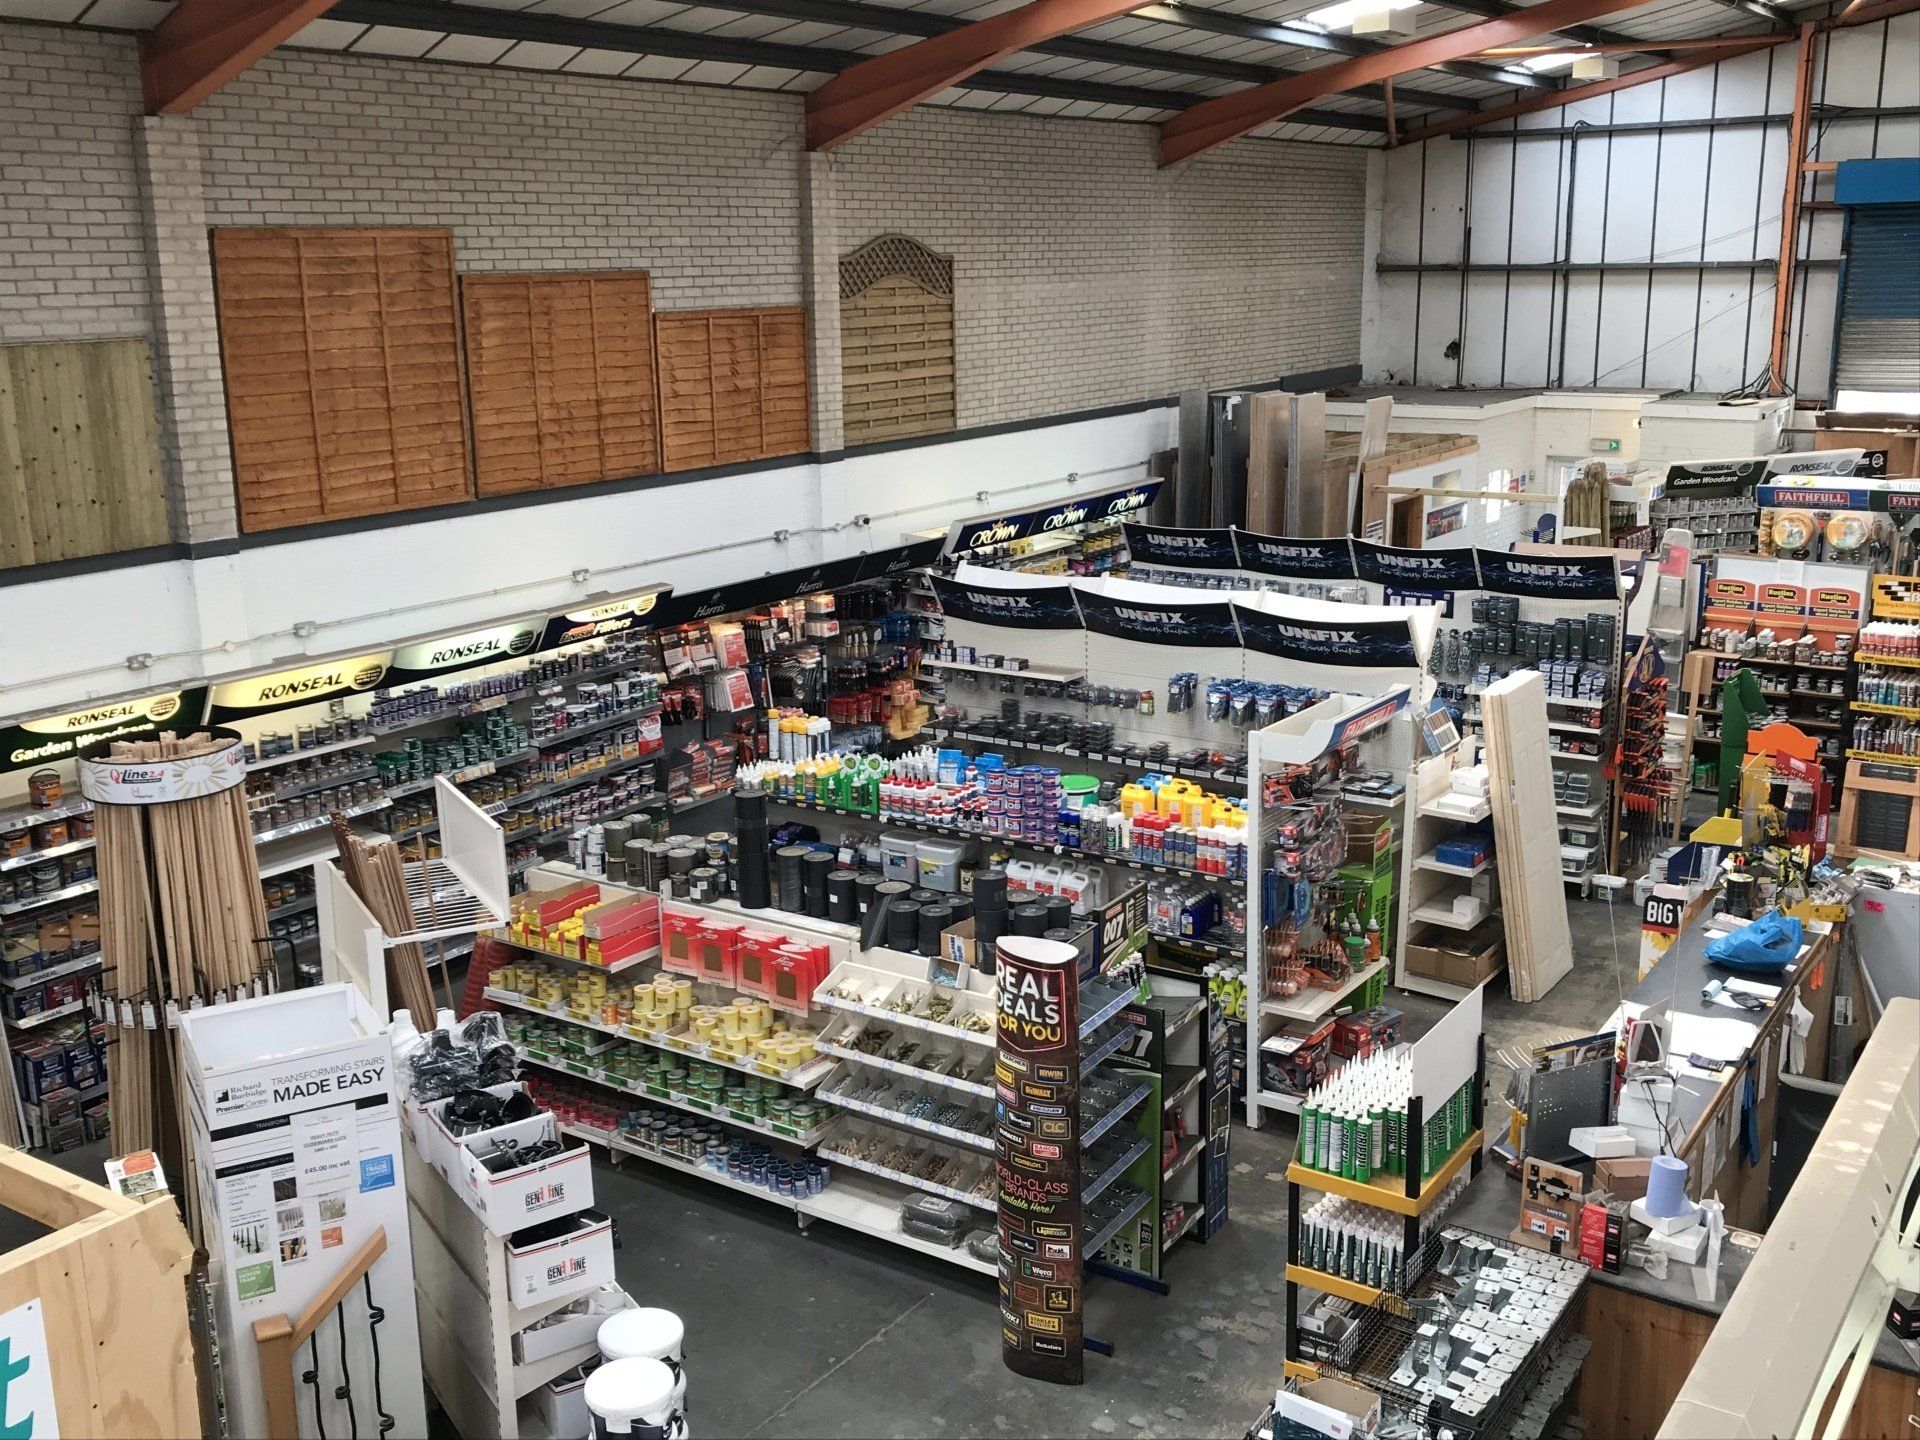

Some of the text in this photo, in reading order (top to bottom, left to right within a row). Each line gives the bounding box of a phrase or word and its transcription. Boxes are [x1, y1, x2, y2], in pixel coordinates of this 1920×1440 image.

[1701, 464, 1733, 472] RONSEAL
[1789, 461, 1836, 473] RONSEAL
[1673, 475, 1738, 486] Garden Woodcare
[1107, 492, 1148, 515] CROWN
[1779, 492, 1845, 503] FAITHFULL
[1043, 508, 1088, 531] CROWN
[969, 523, 1020, 548] CROWN
[886, 559, 911, 573] Harris
[795, 579, 824, 594] Harris
[1718, 584, 1744, 593] Rustins
[1768, 589, 1794, 597] Rustins
[1820, 593, 1847, 601] Rustins
[693, 604, 726, 618] Harris
[593, 617, 633, 635] Fillers
[430, 638, 502, 665] RONSEAL
[258, 673, 343, 701] RONSEAL
[66, 705, 136, 728] RONSEAL
[10, 739, 73, 763] Garden
[1647, 901, 1673, 924] BIG
[1103, 912, 1125, 945] 007
[996, 958, 1059, 1002] REAL
[996, 987, 1060, 1024] DEALS
[1021, 1020, 1061, 1042] YOU
[271, 1055, 385, 1087] TRANSFORMING STAIRS
[1039, 1069, 1063, 1078] IRWIN
[230, 1082, 262, 1095] Richard
[273, 1067, 385, 1103] MADE EASY
[231, 1088, 268, 1102] Burbidge
[255, 1117, 289, 1129] TRANSFORM
[1043, 1122, 1065, 1133] CLC
[1356, 1130, 1369, 1169] GRIPFILL
[304, 1164, 328, 1175] £45.00
[1005, 1181, 1047, 1203] BRANDS
[999, 1190, 1055, 1214] Available Here!
[1546, 1208, 1568, 1219] MATE
[1031, 1266, 1053, 1277] Wera
[1030, 1316, 1056, 1325] STANLEY
